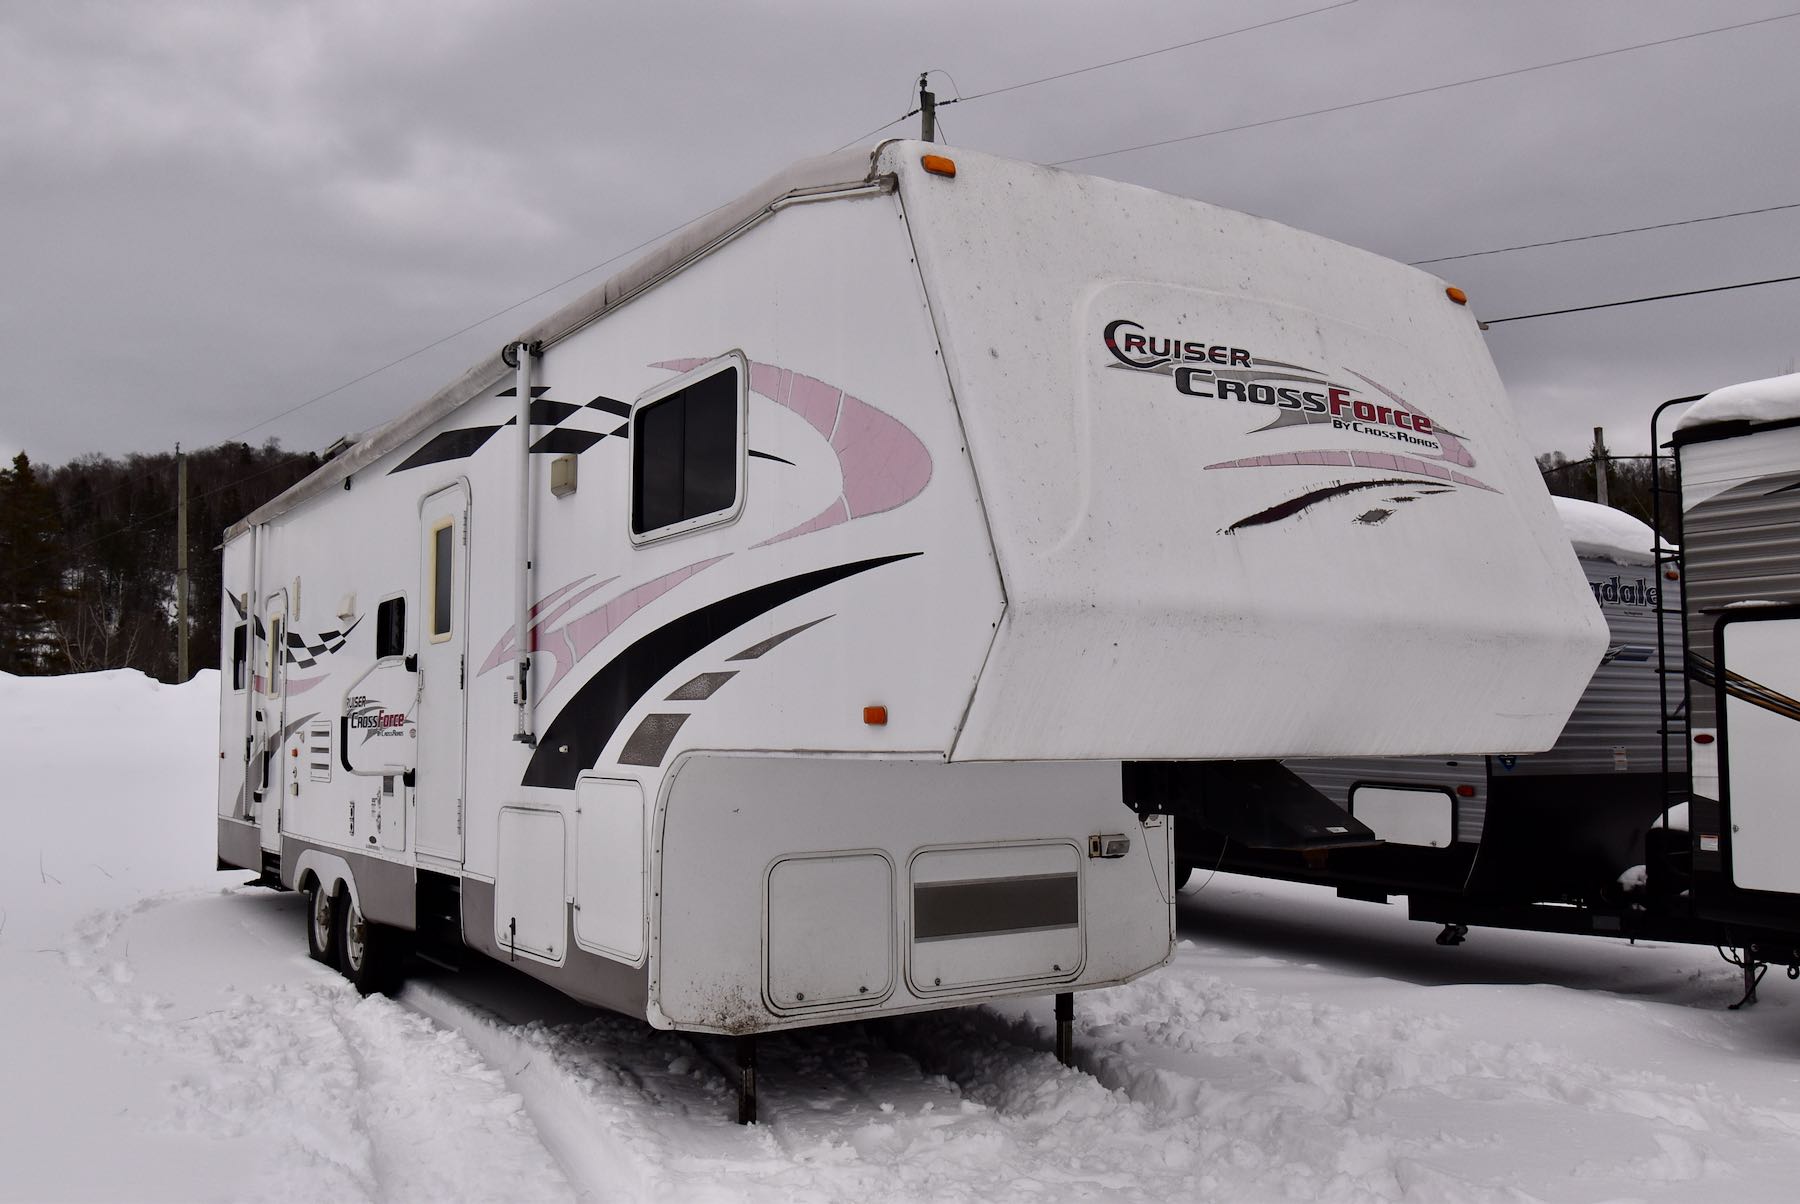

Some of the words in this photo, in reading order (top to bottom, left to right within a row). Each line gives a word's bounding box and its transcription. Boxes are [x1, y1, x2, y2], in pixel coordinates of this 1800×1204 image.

[1103, 319, 1252, 369] CRUISER
[1352, 422, 1440, 450] CROSSROADS
[345, 695, 367, 709] RUISER
